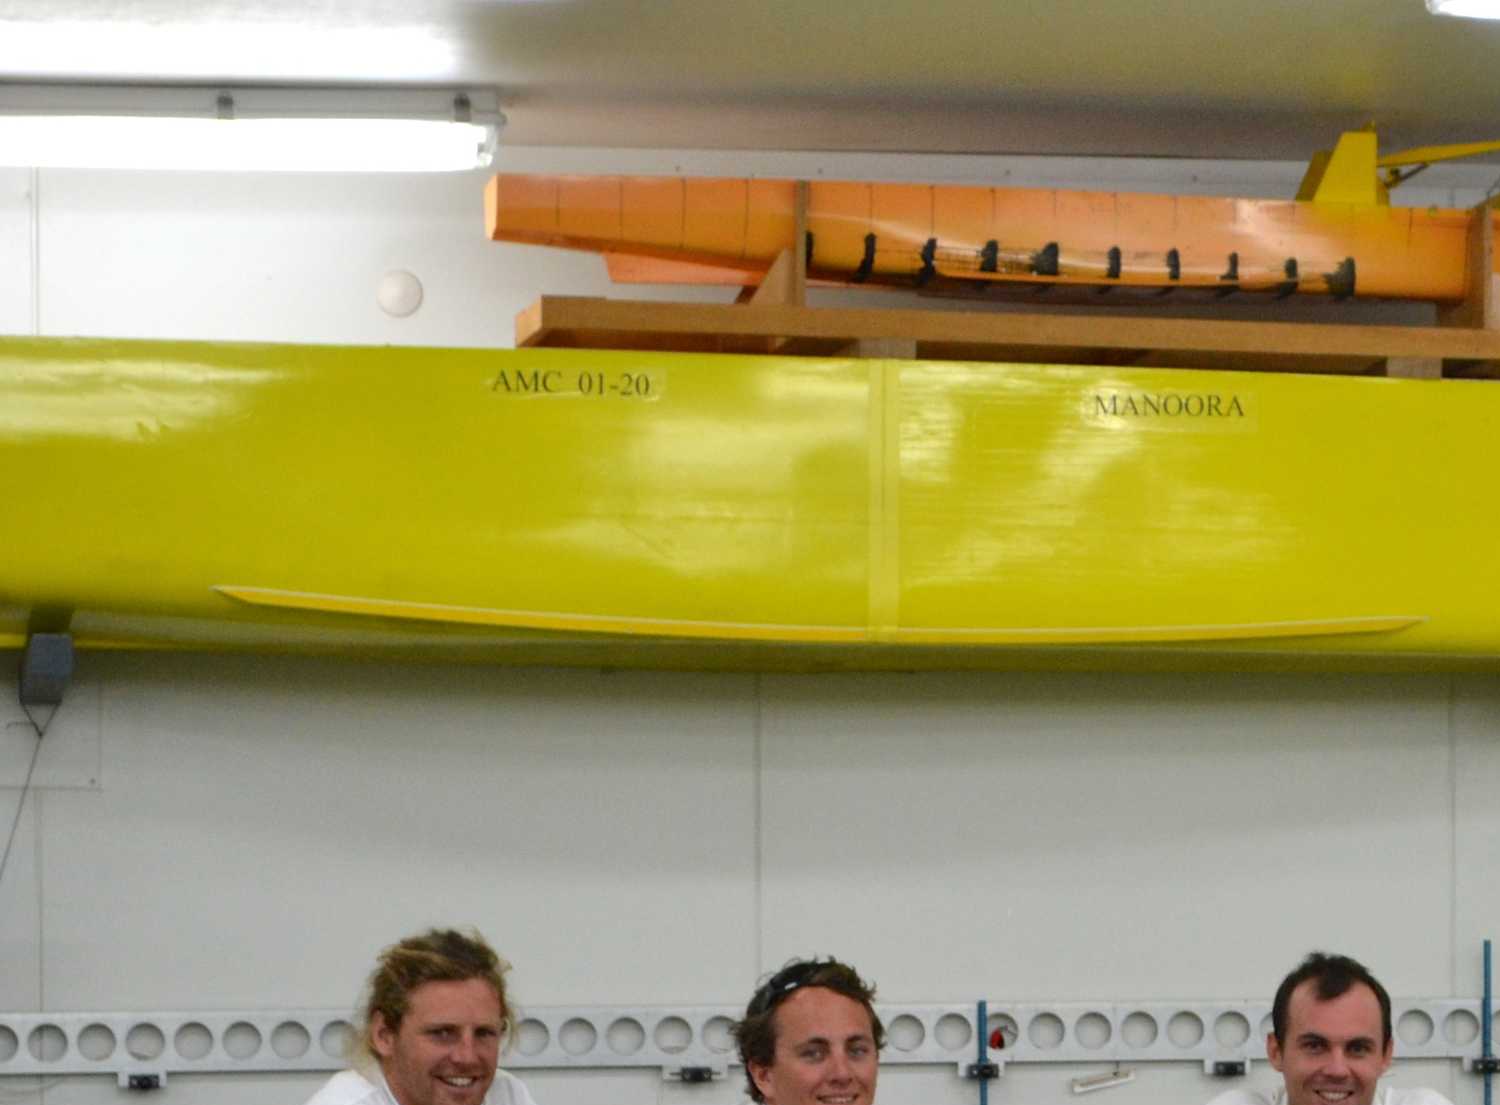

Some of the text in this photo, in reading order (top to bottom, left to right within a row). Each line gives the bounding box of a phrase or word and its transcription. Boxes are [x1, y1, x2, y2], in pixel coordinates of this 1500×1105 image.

[492, 370, 650, 396] AMC 01-20
[1095, 394, 1244, 417] MANOORA
